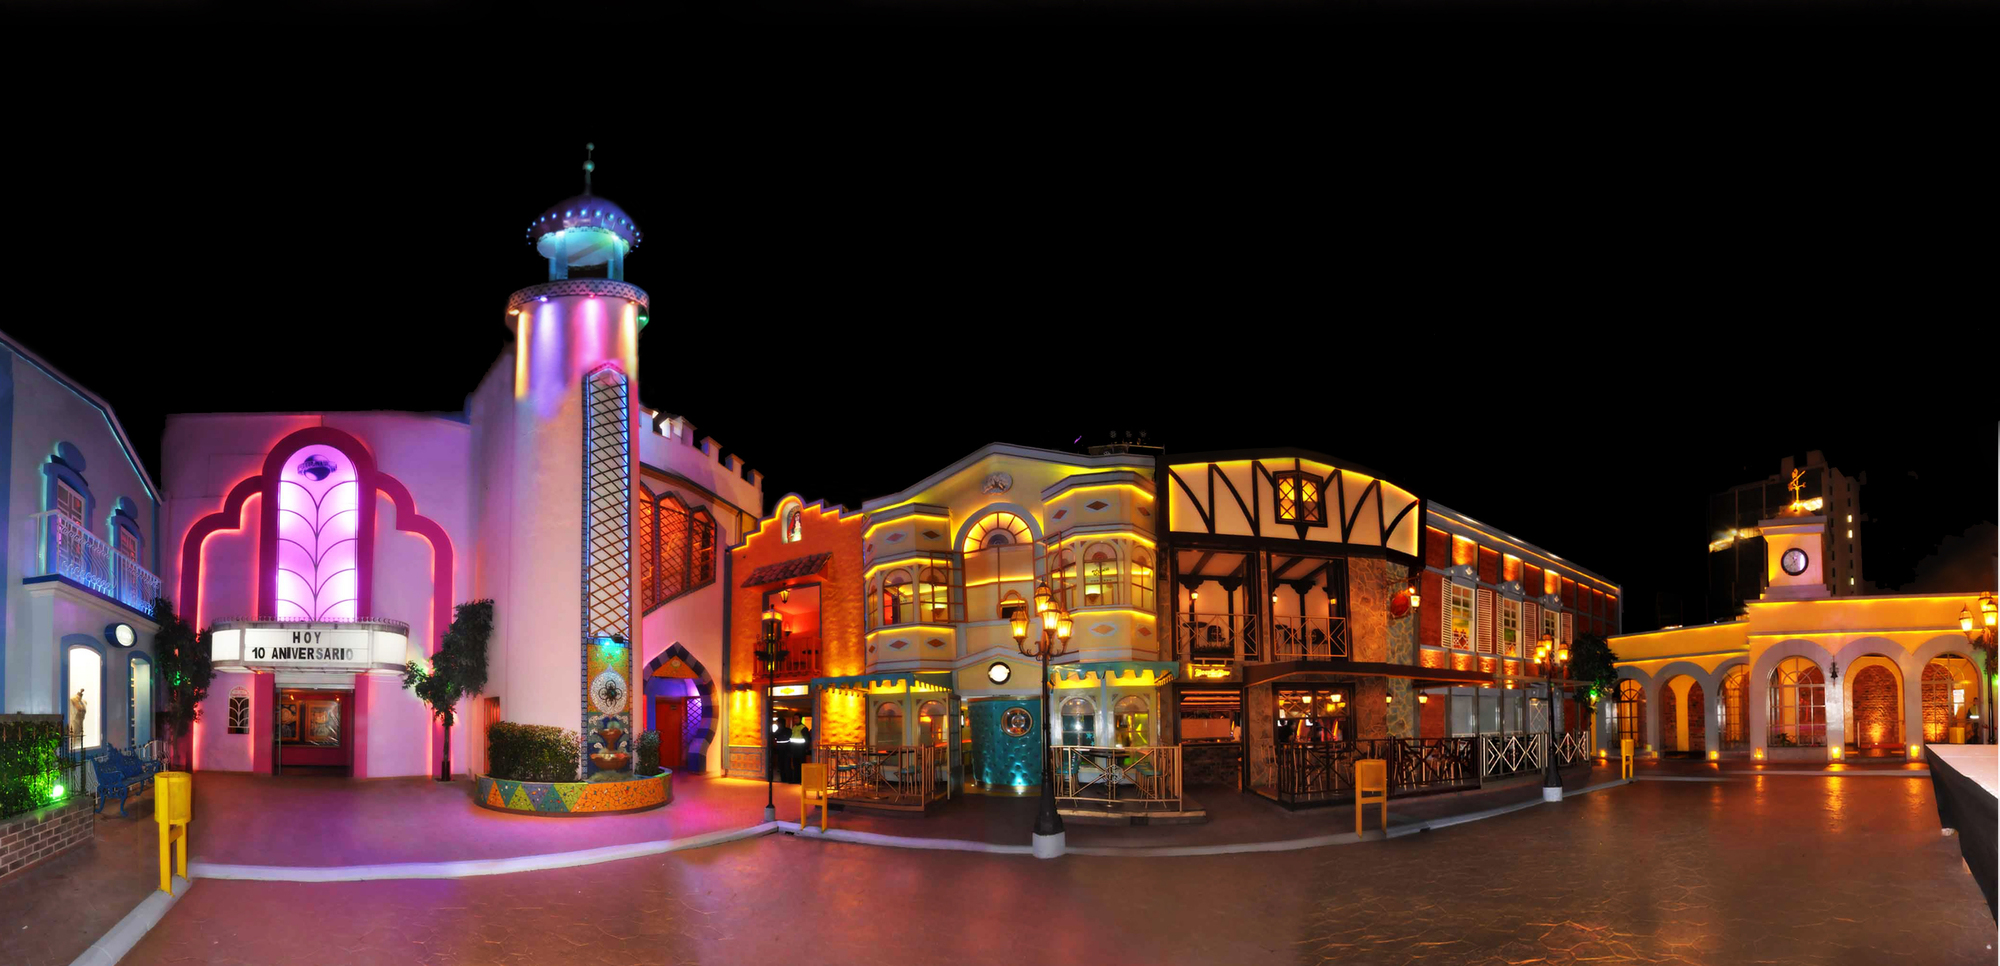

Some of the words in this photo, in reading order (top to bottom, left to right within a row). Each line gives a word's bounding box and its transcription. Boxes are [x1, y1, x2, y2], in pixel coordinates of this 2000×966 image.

[292, 631, 321, 644] HOY
[252, 647, 265, 659] 10
[271, 647, 354, 660] ANIVERSARIO
